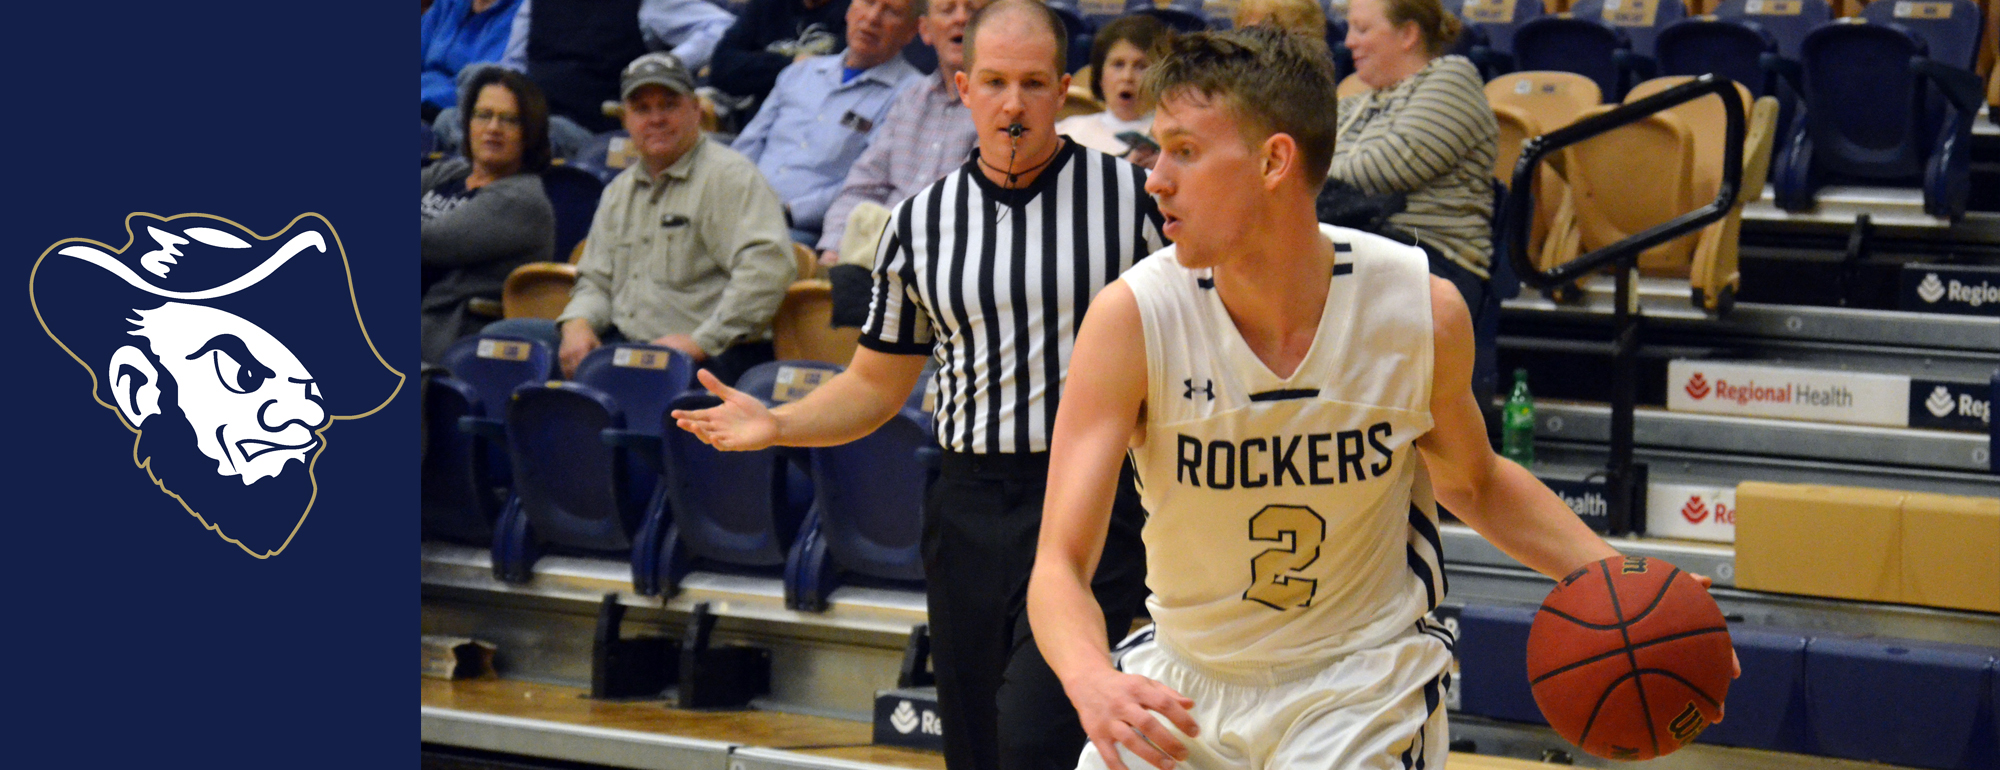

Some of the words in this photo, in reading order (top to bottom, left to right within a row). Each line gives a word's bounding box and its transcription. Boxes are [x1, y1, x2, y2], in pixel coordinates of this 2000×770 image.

[1948, 279, 2000, 307] Regio
[1716, 379, 1792, 405] Regional
[1796, 383, 1853, 407] Health
[1177, 421, 1394, 490] ROCKERS
[1559, 490, 1608, 517] ealth
[1242, 503, 1326, 611] 2
